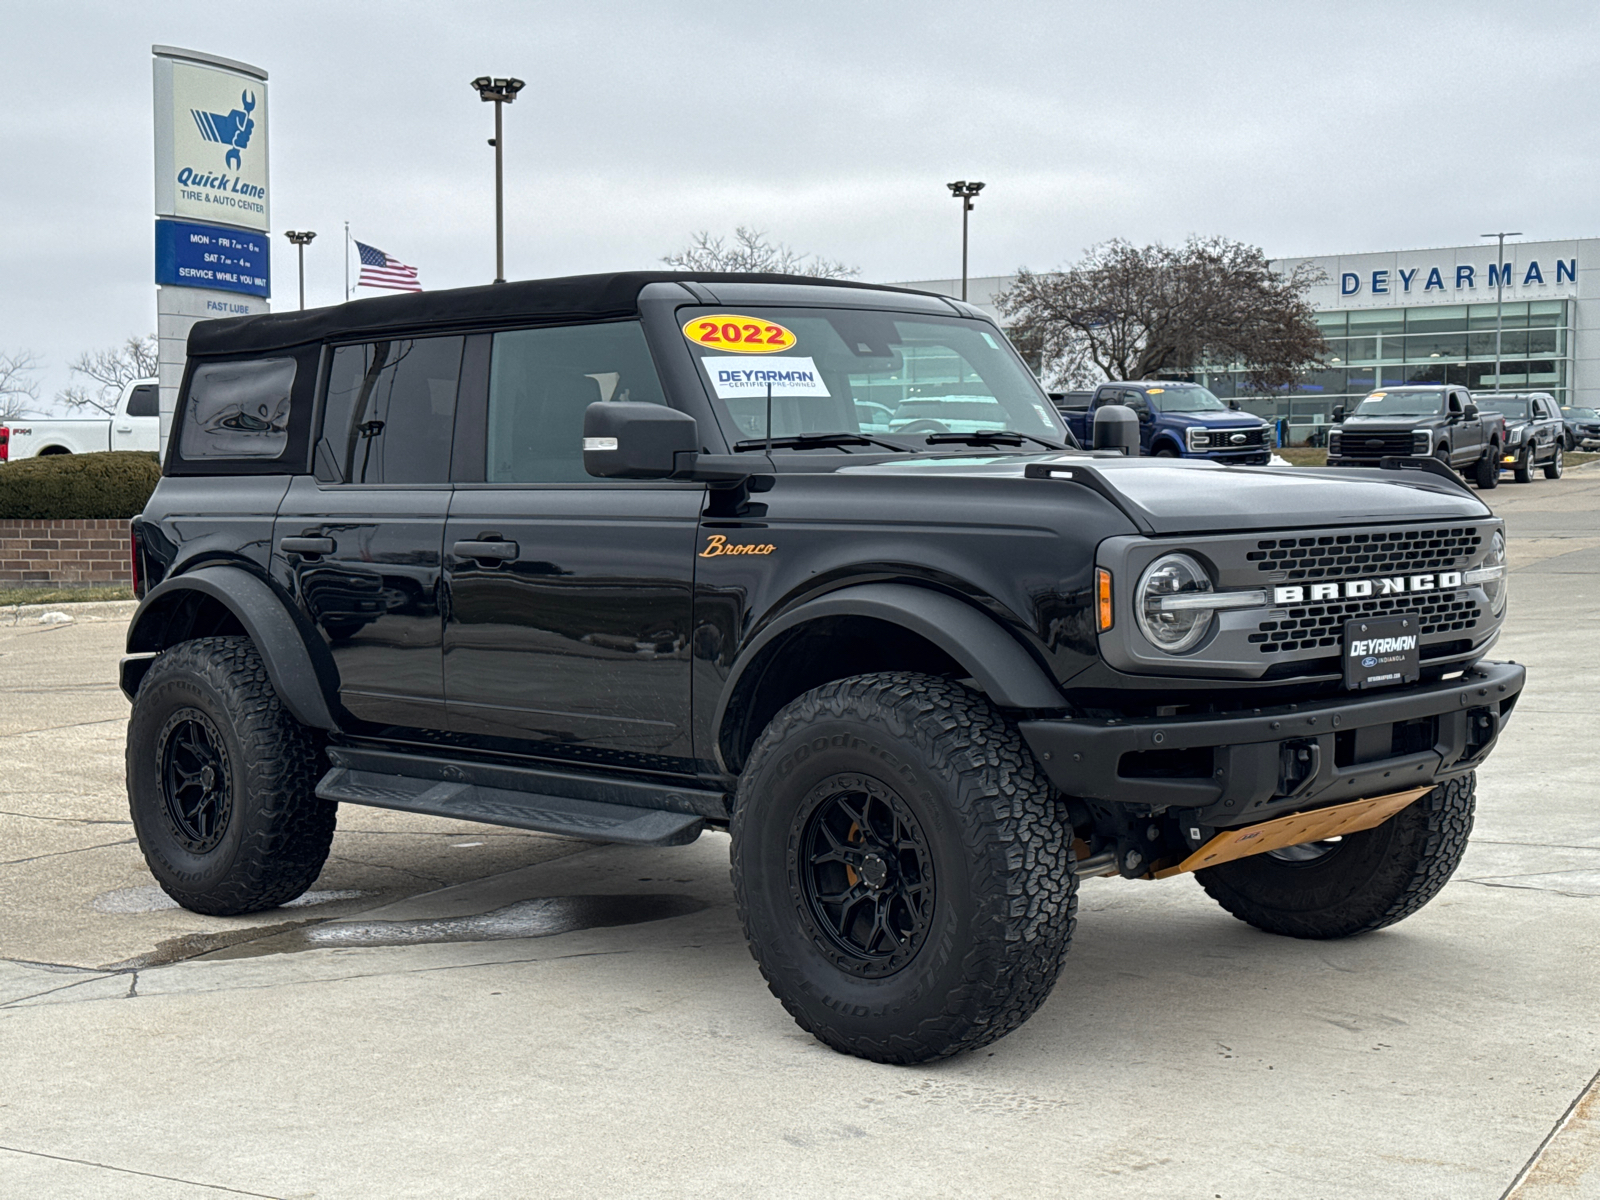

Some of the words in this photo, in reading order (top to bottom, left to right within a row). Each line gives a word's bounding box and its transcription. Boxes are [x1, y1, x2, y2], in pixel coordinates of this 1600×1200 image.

[177, 167, 230, 191] Quick
[231, 177, 265, 199] Lane
[180, 189, 202, 201] TIRE
[204, 193, 211, 203] &
[213, 195, 236, 207] AUTO
[237, 199, 264, 214] CENTER
[190, 234, 209, 244] MON
[218, 238, 230, 247] FRI
[204, 253, 218, 262] SAT
[179, 267, 213, 279] SERVICE
[216, 271, 238, 282] WHILE
[240, 275, 252, 285] YOU
[254, 277, 266, 287] WAIT
[1341, 258, 1577, 296] DEYARMAN
[207, 300, 228, 312] FAST
[229, 303, 249, 314] LUBE
[698, 322, 787, 345] 2022
[718, 370, 814, 382] DEYARMAN
[698, 534, 777, 558] Bronco
[1274, 571, 1462, 604] BRONCO
[1350, 635, 1417, 657] DEYARMAN
[1378, 655, 1406, 664] INDIANOLA
